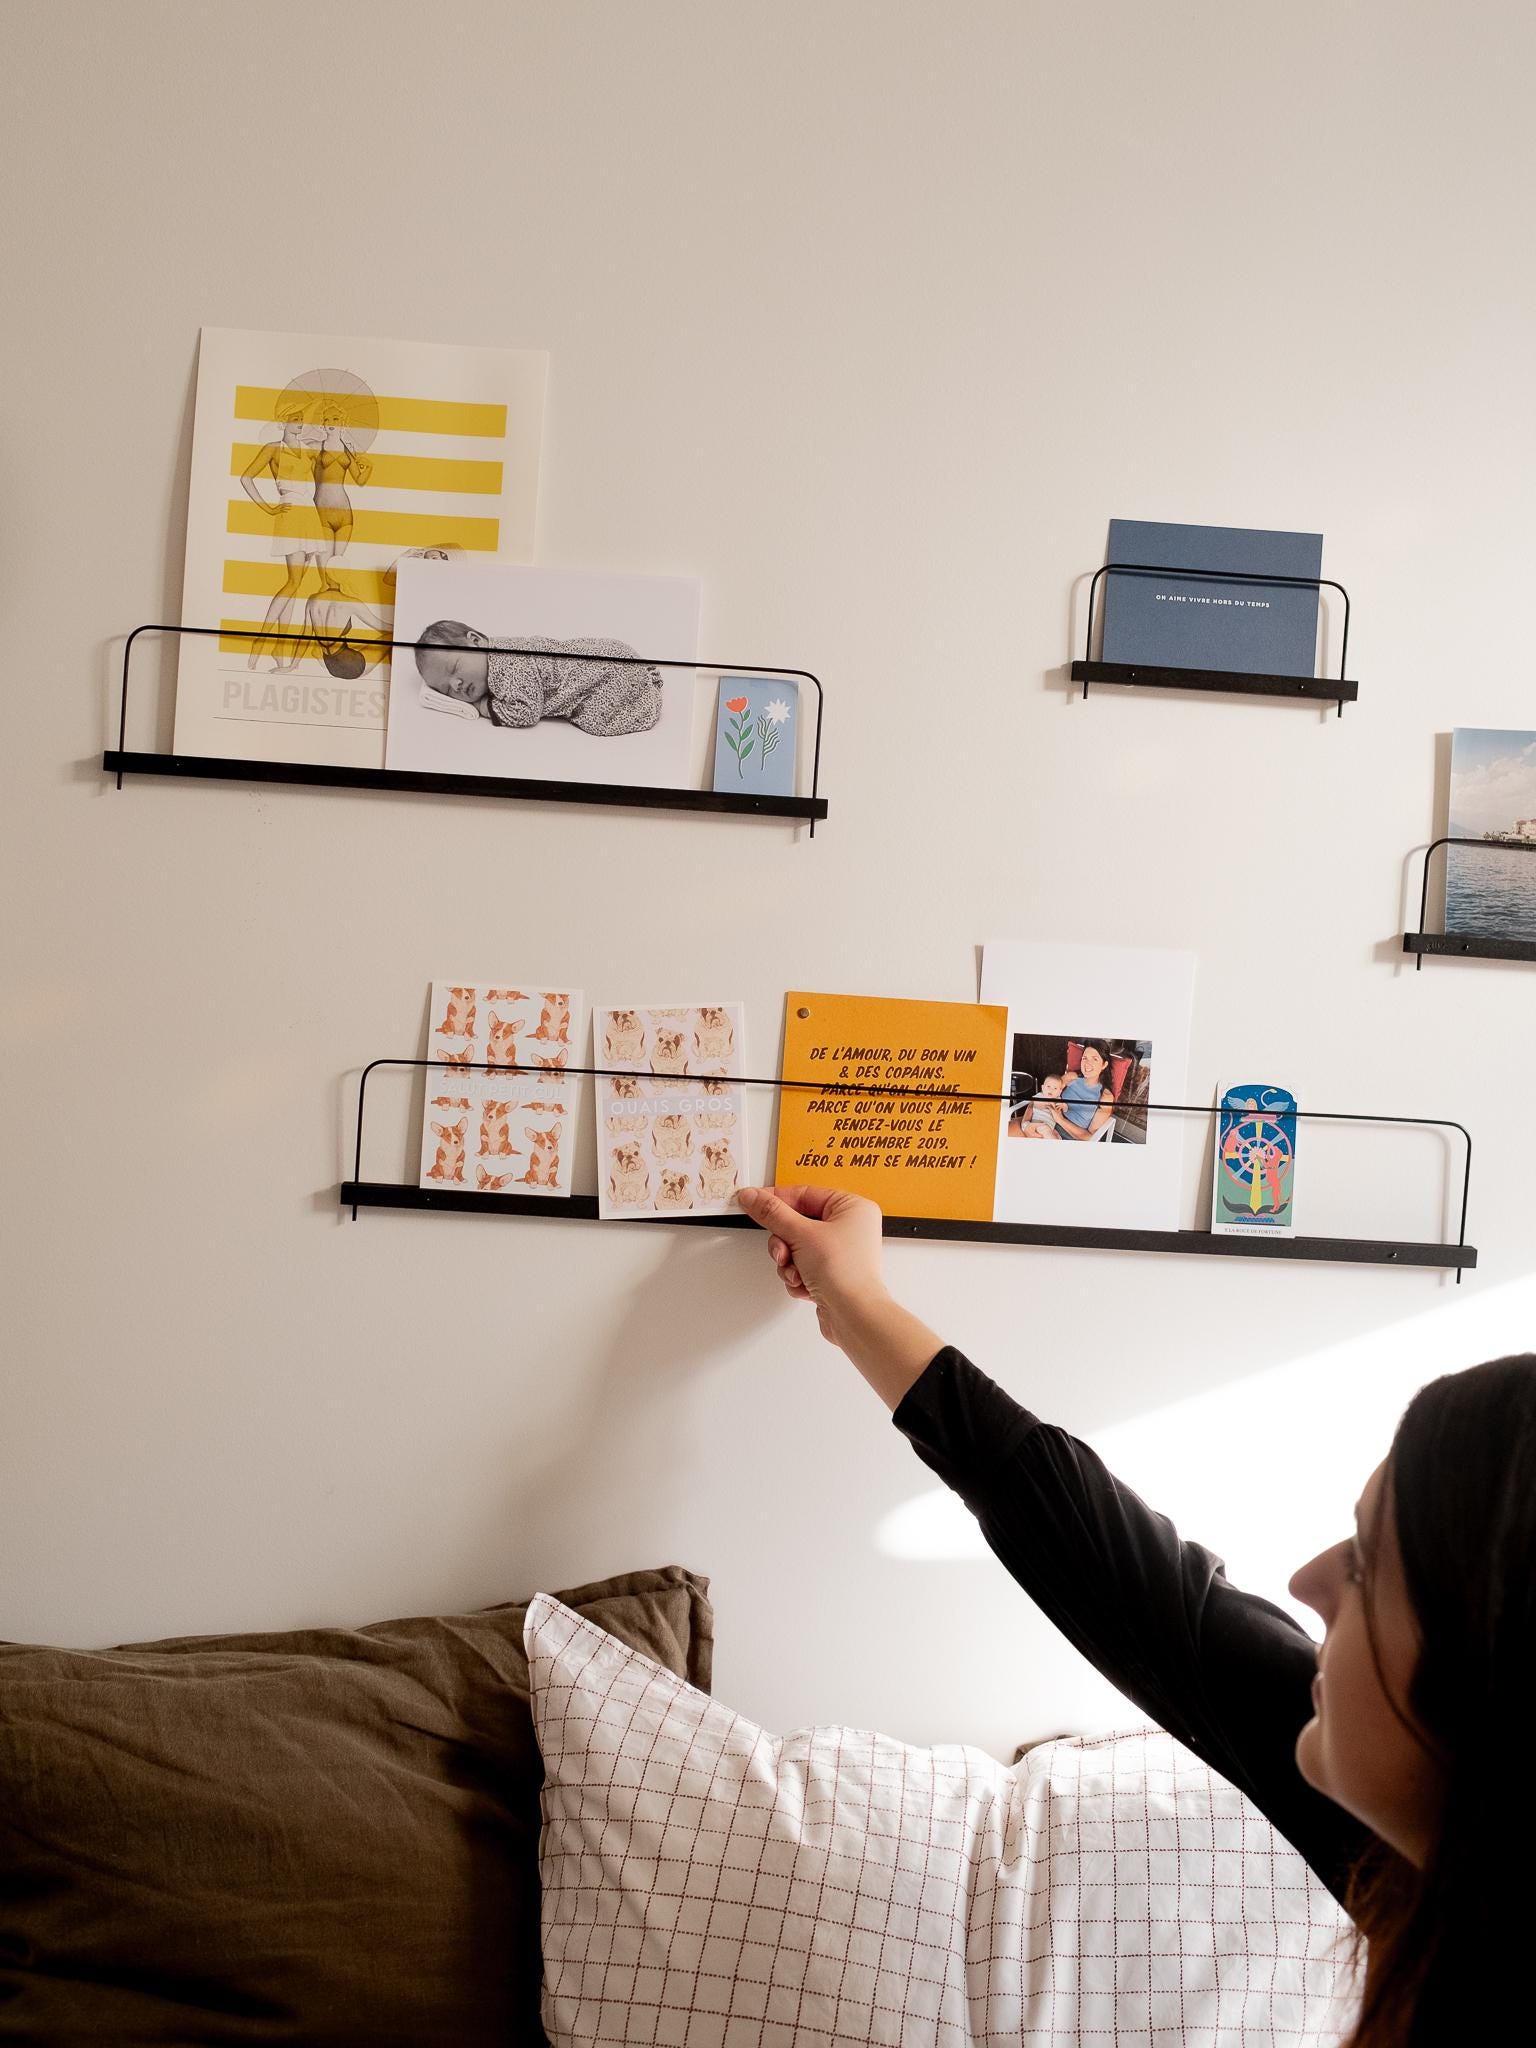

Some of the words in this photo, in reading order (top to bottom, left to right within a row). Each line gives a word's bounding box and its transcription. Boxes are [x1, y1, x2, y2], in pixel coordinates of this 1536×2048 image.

[222, 680, 388, 719] PLAGISTES
[809, 1047, 829, 1060] DE
[832, 1046, 893, 1062] L'AMOUR,
[897, 1048, 916, 1061] DU
[920, 1049, 949, 1062] BON
[953, 1049, 977, 1063] VIN
[839, 1066, 849, 1078] &
[855, 1065, 881, 1079] DES
[885, 1066, 945, 1079] COPAINS.
[610, 1099, 670, 1115] OUAIS
[679, 1097, 733, 1113] GROS
[806, 1100, 850, 1113] PARCE
[854, 1100, 895, 1114] QU'ON
[899, 1101, 933, 1114] VOUS
[936, 1101, 973, 1115] AIME.
[833, 1118, 924, 1131] RENDEZ-VOUS
[928, 1119, 944, 1131] LE
[826, 1136, 835, 1148] 2
[840, 1136, 913, 1149] NOVEMBRE
[917, 1137, 949, 1149] 2019.
[795, 1149, 829, 1167] JÉRO
[834, 1155, 844, 1167] &
[849, 1154, 880, 1167] MAT
[883, 1155, 901, 1167] SE
[905, 1155, 966, 1168] MARIENT
[970, 1155, 977, 1168] !
